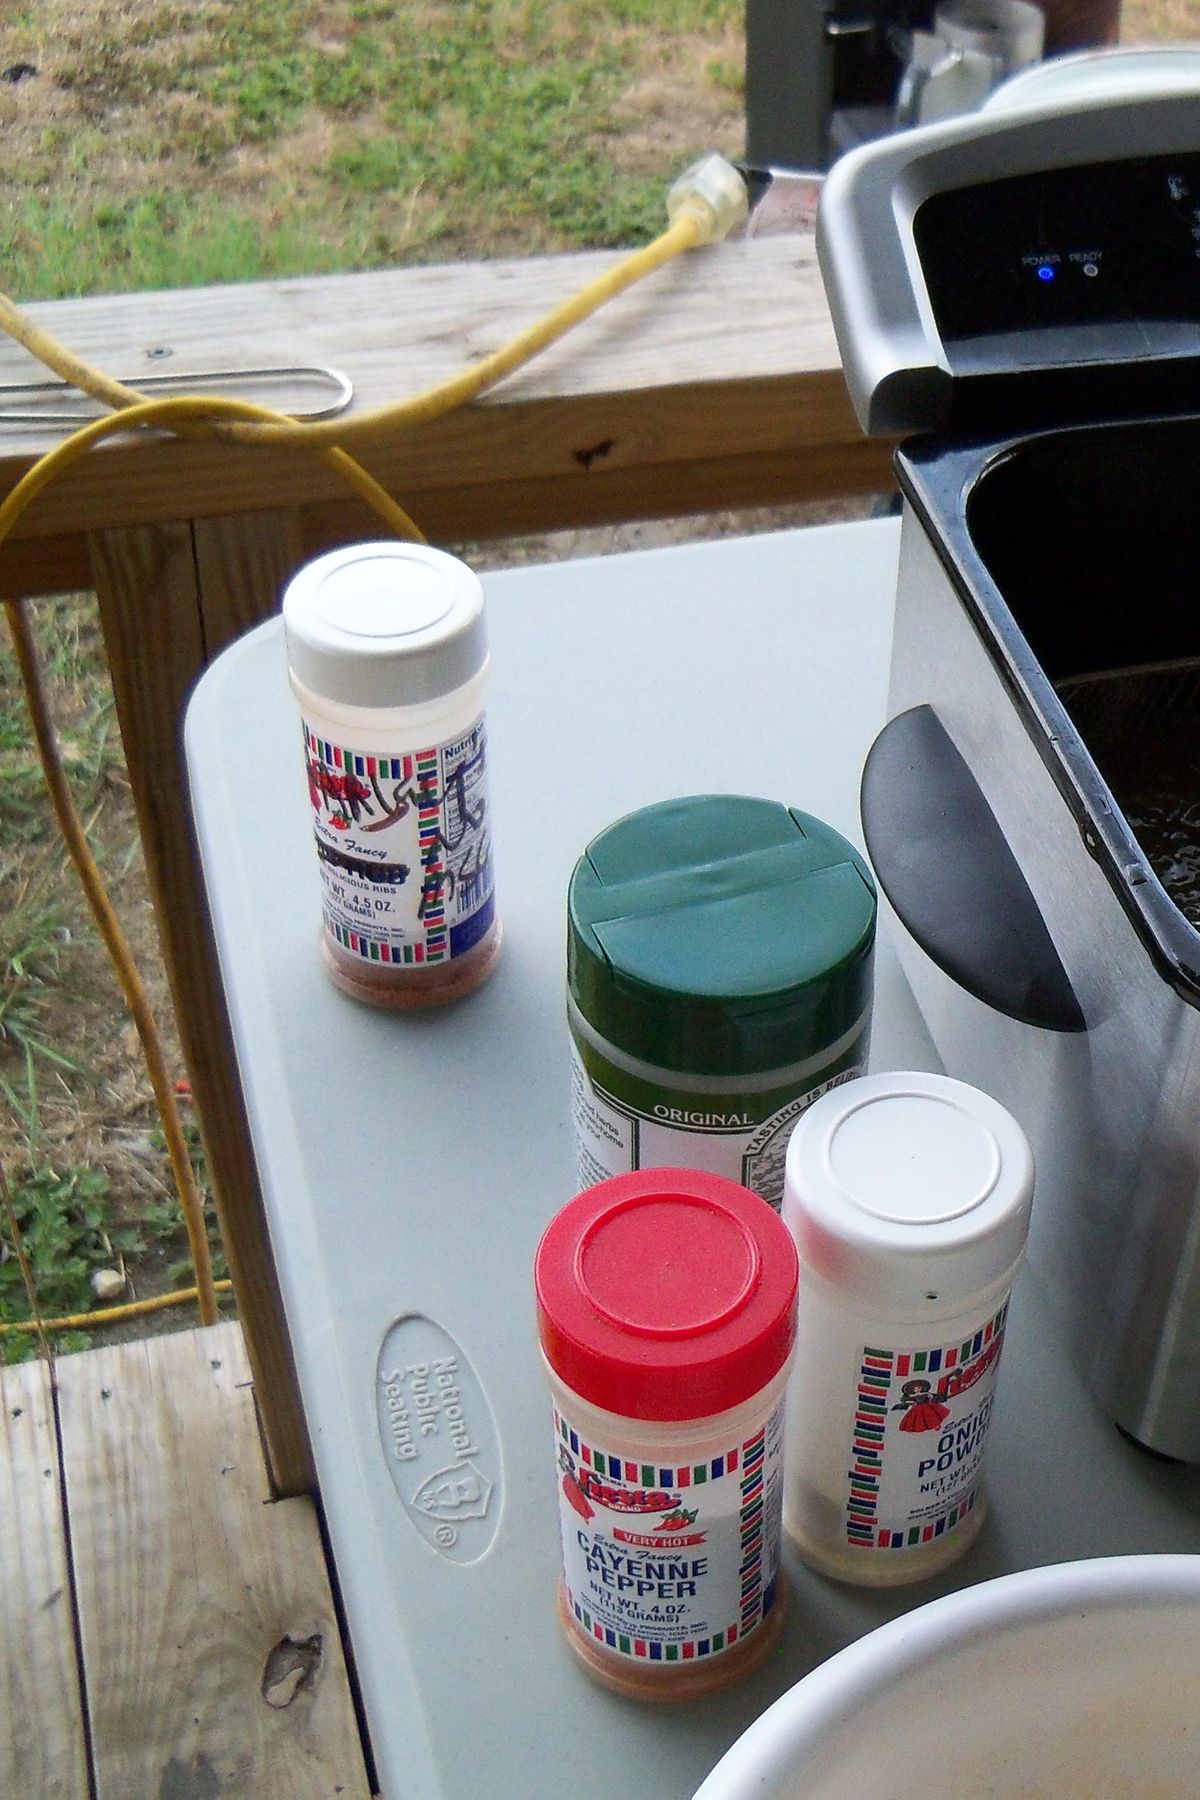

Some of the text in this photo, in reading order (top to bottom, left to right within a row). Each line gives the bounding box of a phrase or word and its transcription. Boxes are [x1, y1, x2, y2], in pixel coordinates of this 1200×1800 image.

[344, 839, 388, 860] Fancy
[352, 895, 372, 909] 4.5
[374, 899, 397, 913] OZ.
[653, 1104, 754, 1127] ORIGINAL
[746, 1102, 801, 1153] TASTING
[807, 1089, 821, 1102] IS
[382, 1367, 419, 1462] Seating
[406, 1362, 439, 1437] Public
[433, 1356, 479, 1461] National
[937, 1401, 992, 1453] ONIO
[918, 1420, 991, 1478] POWD
[920, 1478, 946, 1493] NET
[577, 1529, 709, 1581] CAYENNE
[623, 1533, 690, 1547] VERY HOT
[635, 1550, 683, 1564] Fancy
[586, 1555, 697, 1599] PEPPER
[590, 1580, 613, 1600] NET
[617, 1596, 645, 1612] WT.
[651, 1605, 660, 1613] 4
[665, 1604, 691, 1614] OZ.
[627, 1609, 680, 1624] GRAMS)
